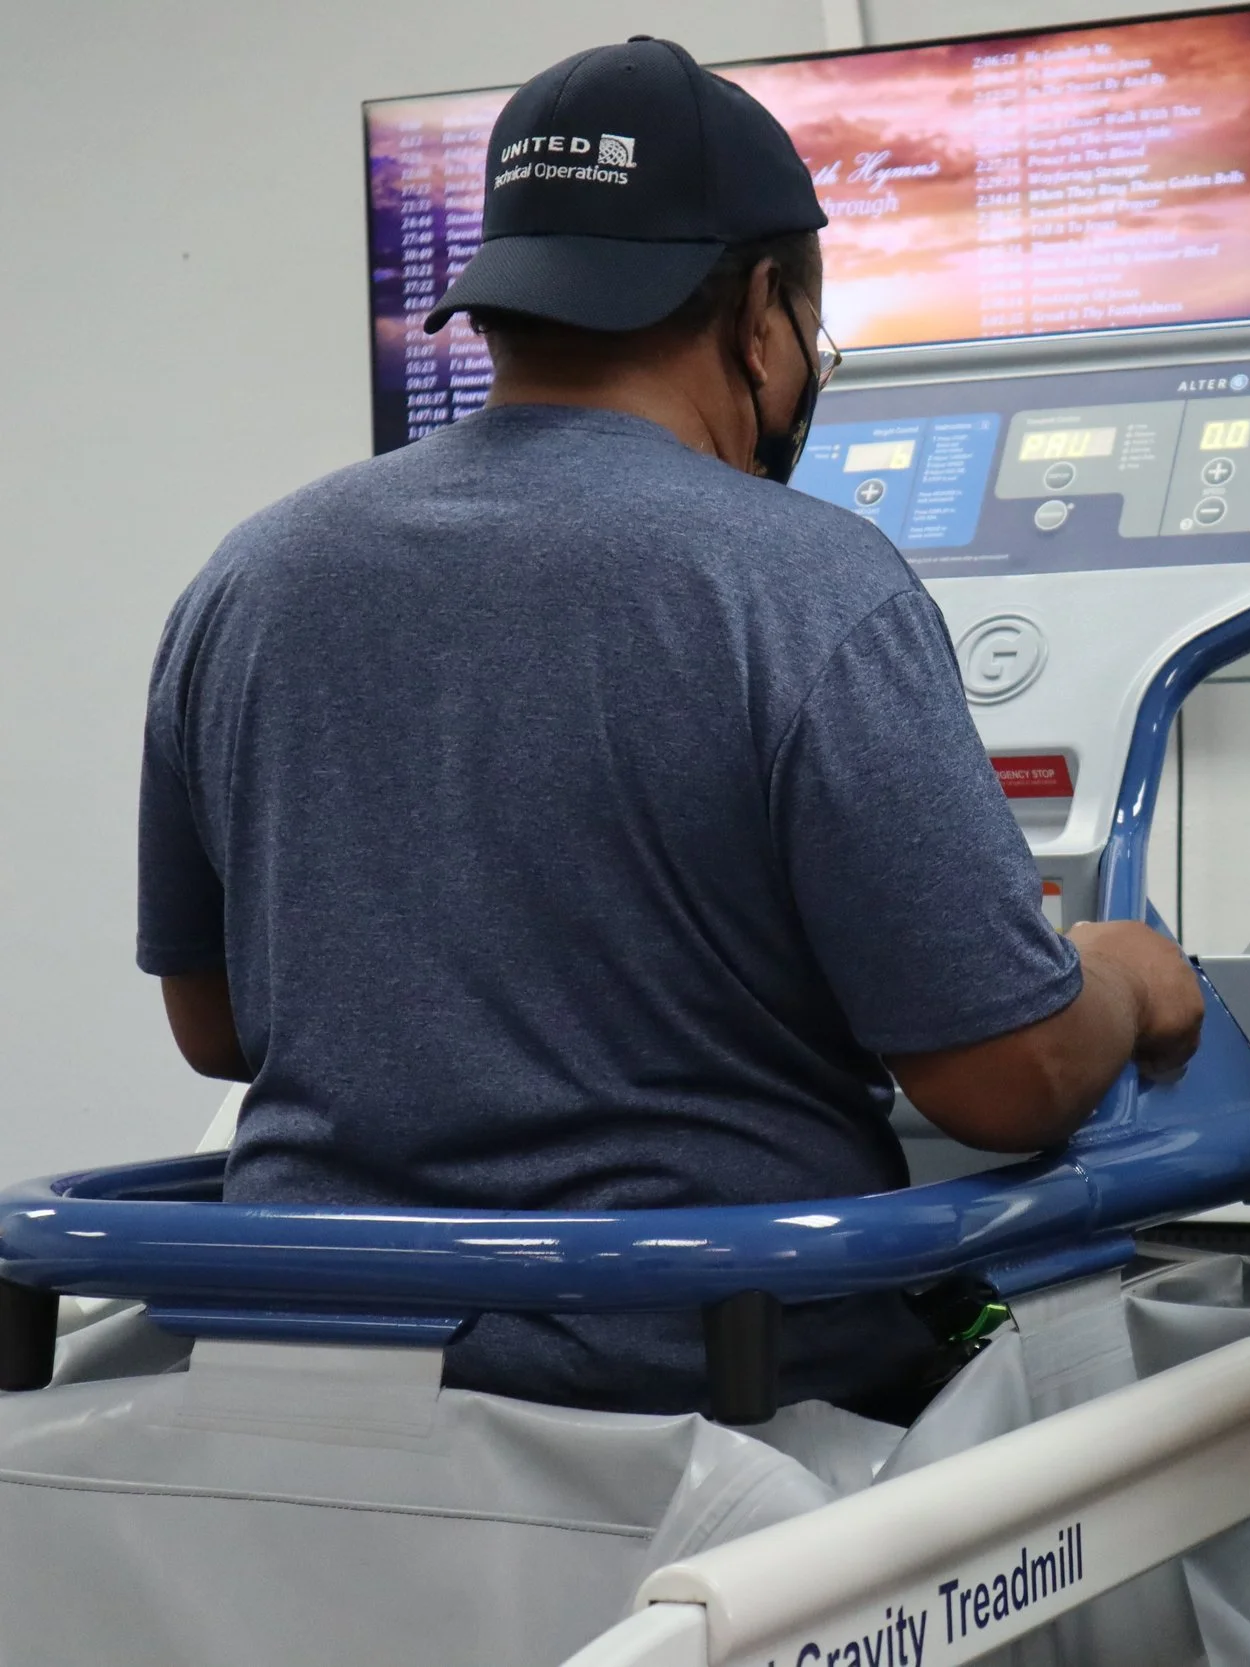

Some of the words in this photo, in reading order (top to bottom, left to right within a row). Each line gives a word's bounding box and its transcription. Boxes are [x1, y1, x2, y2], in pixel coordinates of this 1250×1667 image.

[501, 136, 591, 163] UNITED
[534, 162, 628, 195] Operations
[847, 150, 941, 194] Hymns
[824, 191, 899, 219] hrough
[1177, 379, 1228, 392] ALTER
[999, 770, 1029, 780] GENCY
[1031, 768, 1055, 779] STOP
[938, 1523, 1083, 1644] Treadmill
